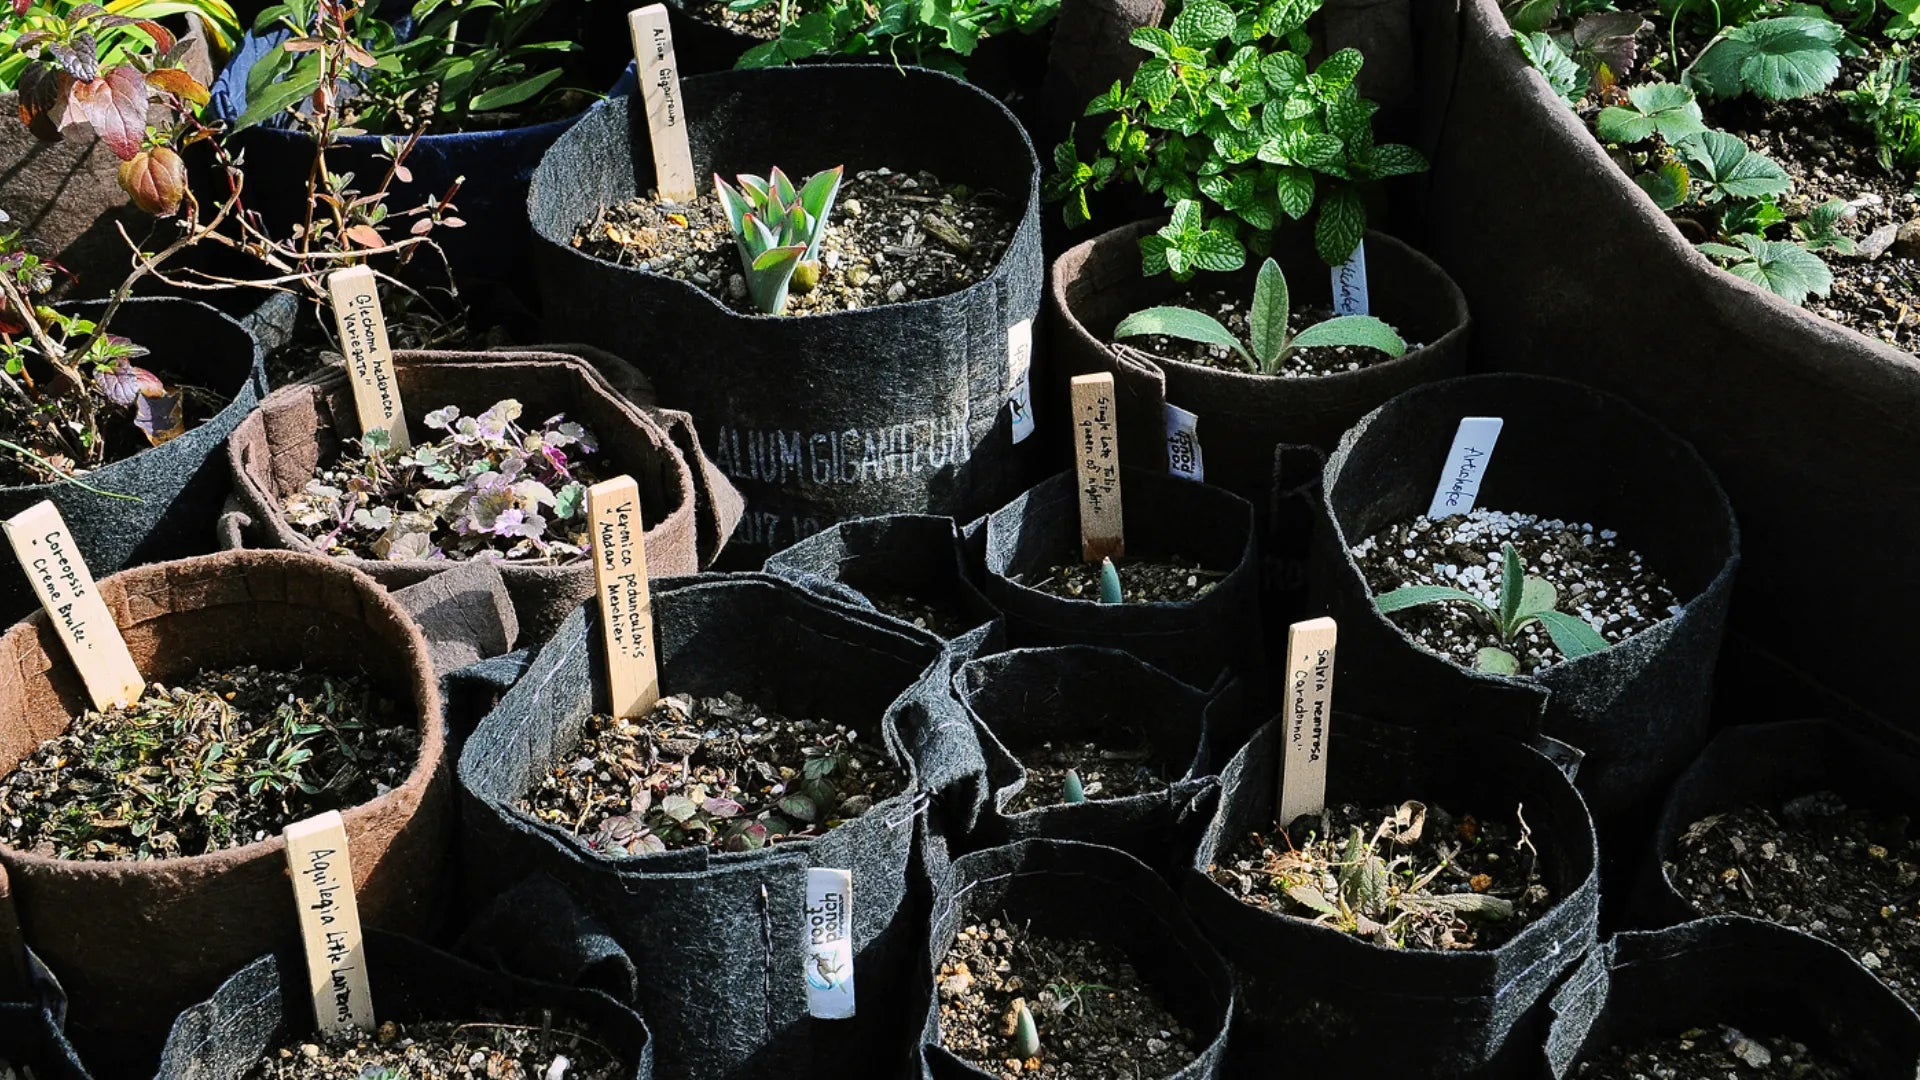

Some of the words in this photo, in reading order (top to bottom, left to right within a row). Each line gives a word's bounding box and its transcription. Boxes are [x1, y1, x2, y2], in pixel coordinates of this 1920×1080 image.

[355, 293, 378, 355] Glechoma
[716, 424, 804, 484] ALIUM
[1167, 434, 1181, 471] root
[44, 530, 86, 598] Coreopsis
[1314, 648, 1330, 693] Salvia
[302, 848, 341, 926] Aquilegia
[806, 906, 824, 946] root
[819, 892, 844, 944] pouch
